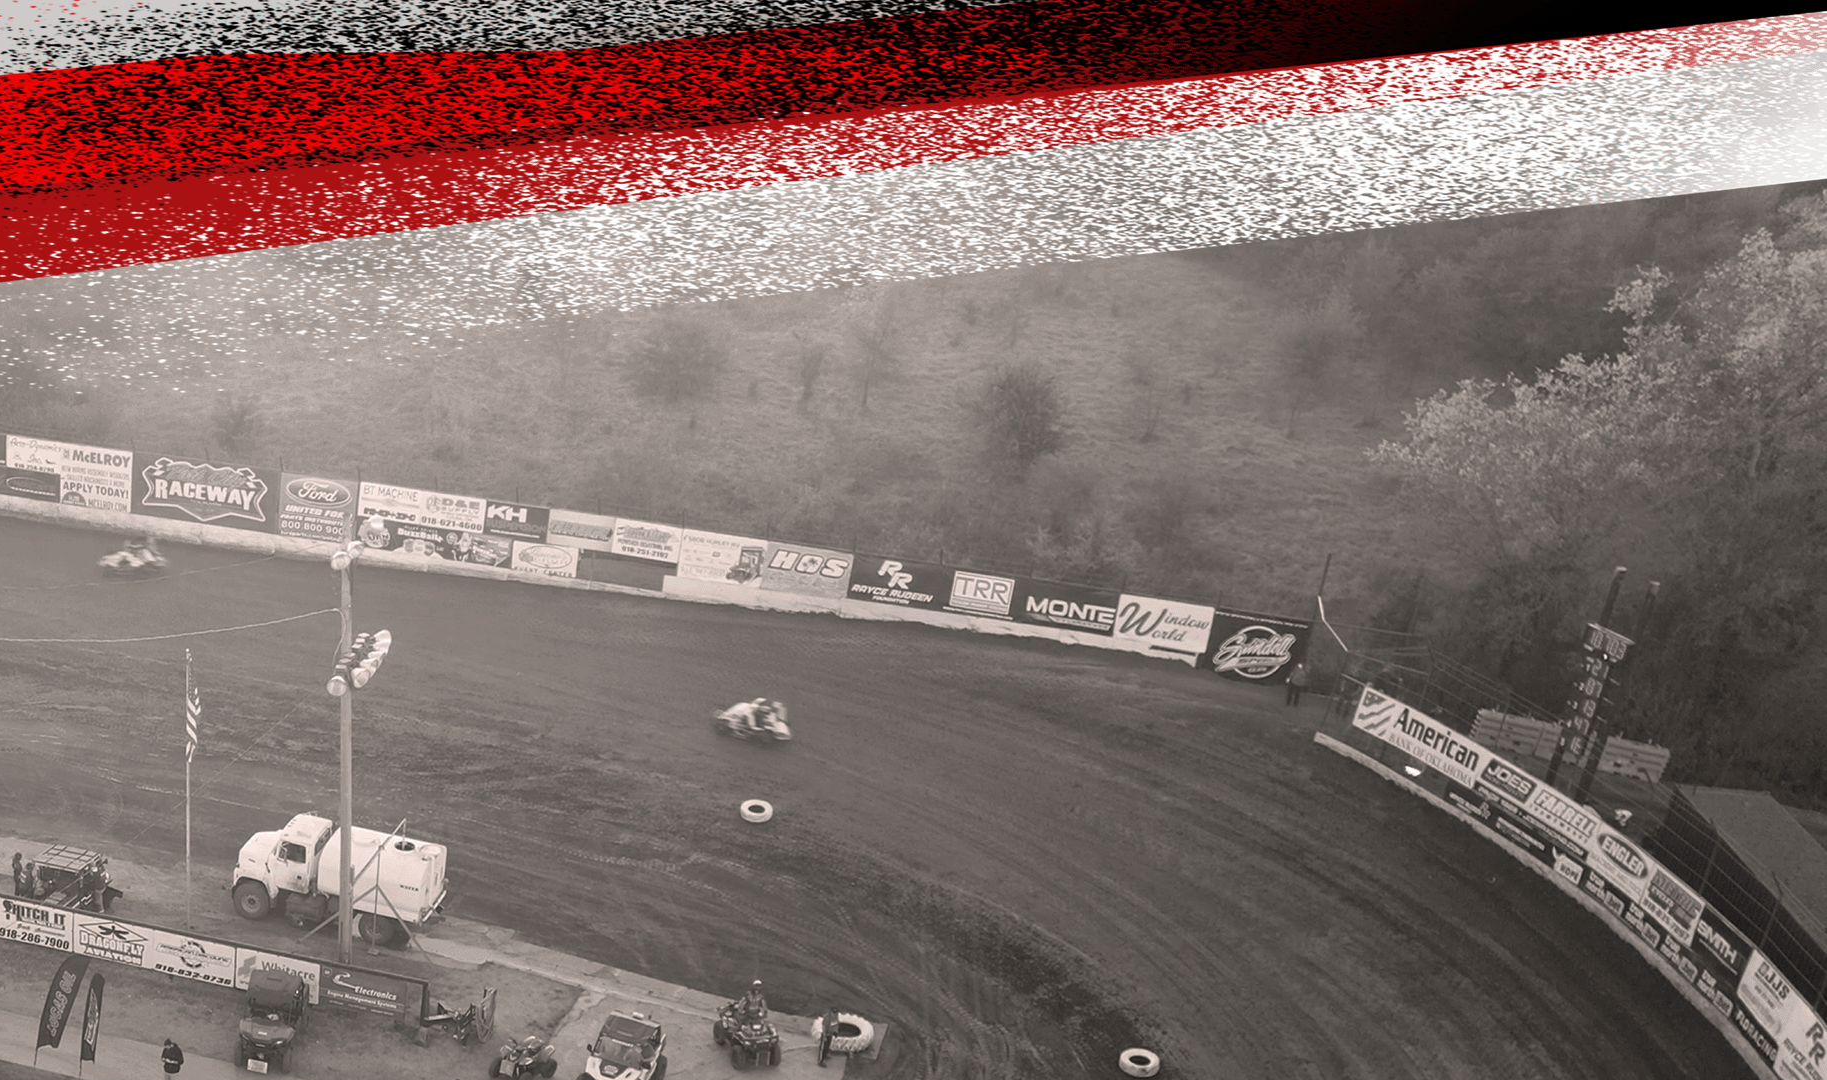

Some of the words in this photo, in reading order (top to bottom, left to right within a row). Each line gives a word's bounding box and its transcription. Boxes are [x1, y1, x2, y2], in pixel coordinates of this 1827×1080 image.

[71, 449, 132, 468] McELROY
[63, 480, 93, 494] APPLY
[95, 484, 129, 499] TODAY!
[155, 478, 256, 511] RACEWAY
[298, 481, 339, 503] Ford
[363, 484, 377, 495] BT
[378, 485, 419, 501] MACHINE
[487, 504, 528, 523] KH
[851, 583, 888, 597] RAYCE
[889, 588, 935, 604] RUDEEN
[954, 578, 1010, 606] TRR
[1025, 594, 1117, 625] MONTE
[1393, 707, 1480, 771] American
[1486, 763, 1533, 795] JOES
[1534, 790, 1598, 835] FARRELL
[1601, 835, 1646, 876] ENGLER
[12, 903, 52, 921] HITCH
[79, 930, 145, 957] DRAGONFLY
[84, 945, 143, 966] AVIATION
[45, 990, 68, 1037] LUCAS
[58, 969, 78, 996] OIL
[354, 984, 398, 1002] Electronics
